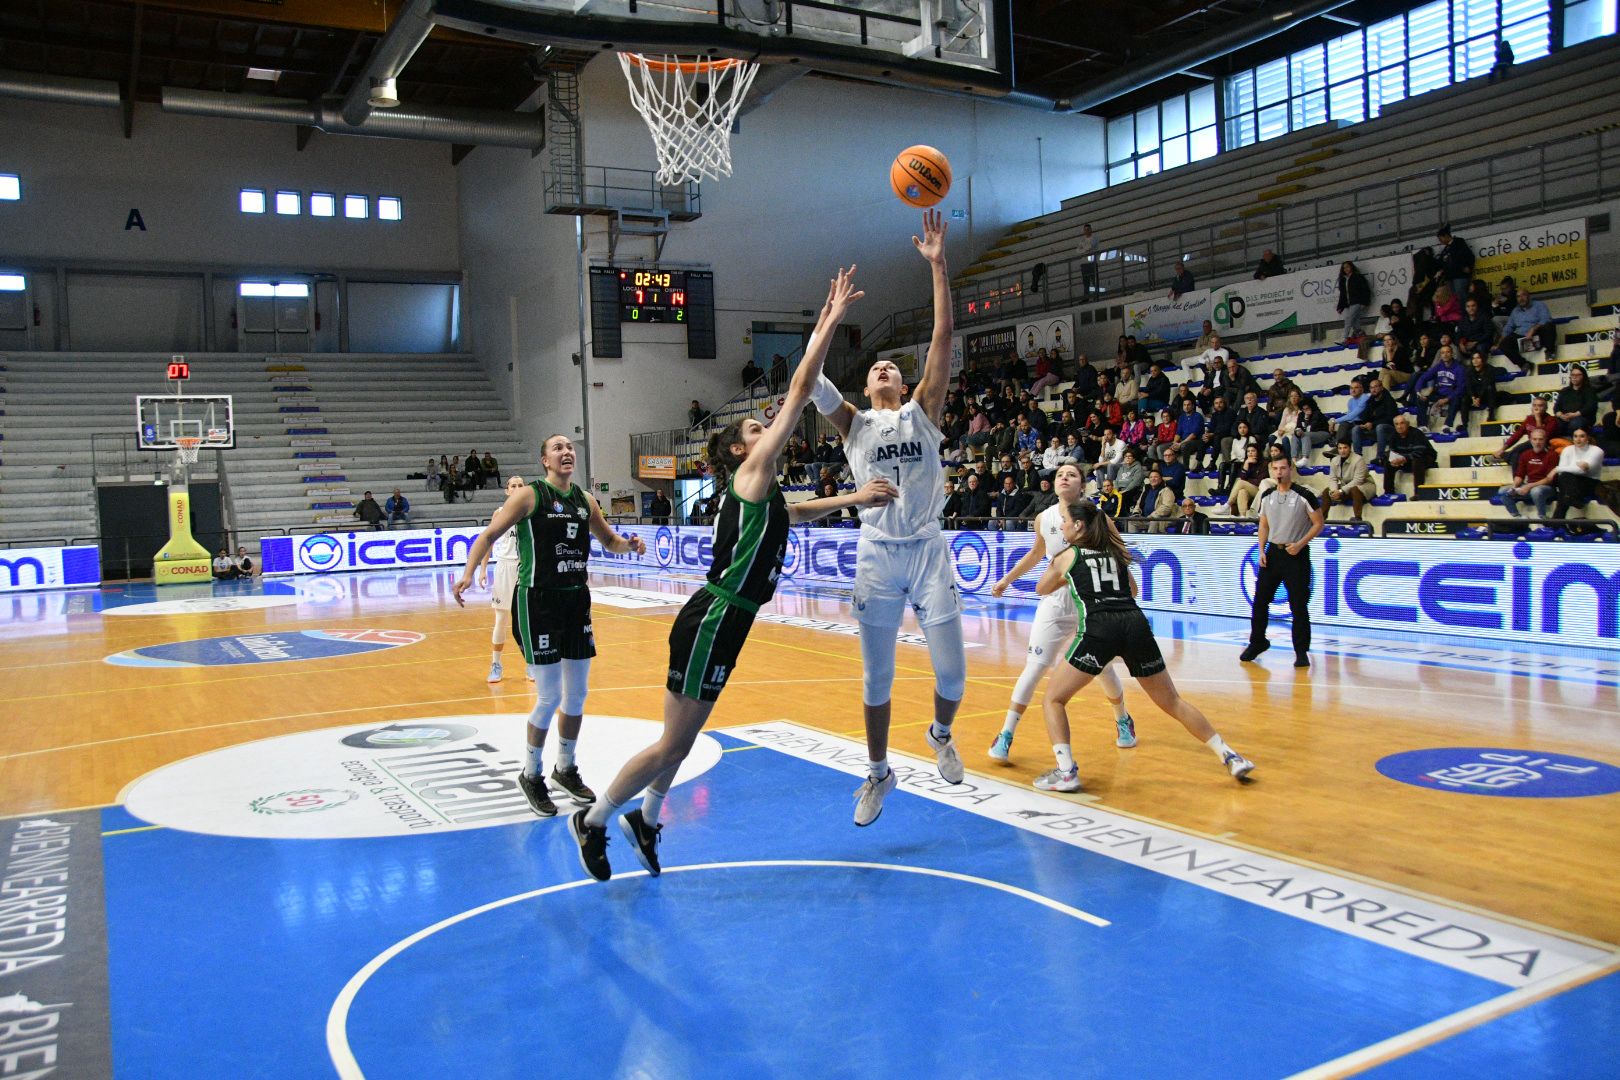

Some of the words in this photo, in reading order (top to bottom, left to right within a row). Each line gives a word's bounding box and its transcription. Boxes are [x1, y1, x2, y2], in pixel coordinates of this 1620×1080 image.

[909, 158, 942, 190] Wilson
[125, 209, 146, 231] A
[1478, 238, 1512, 258] cafè
[1537, 230, 1580, 247] shop
[1526, 255, 1560, 267] Domenico
[635, 272, 671, 287] 02:43
[1530, 272, 1548, 286] CAR
[1551, 268, 1577, 282] WASH
[635, 290, 644, 304] 7
[671, 292, 684, 305] 14
[1260, 290, 1286, 299] PROJECT
[632, 309, 639, 320] 0
[676, 310, 683, 321] 2
[1587, 330, 1616, 343] MOR
[168, 364, 188, 378] 07
[876, 441, 922, 462] ARAN
[1438, 487, 1480, 500] MORE
[566, 522, 579, 539] 6
[1406, 522, 1447, 534] MORE
[804, 530, 857, 577] ice
[171, 565, 209, 576] CONAD
[1085, 556, 1120, 592] 14
[539, 633, 550, 649] 6
[340, 760, 382, 788] ecologia
[379, 794, 442, 829] trasporti
[1043, 816, 1544, 977] BIENNEARREDA
